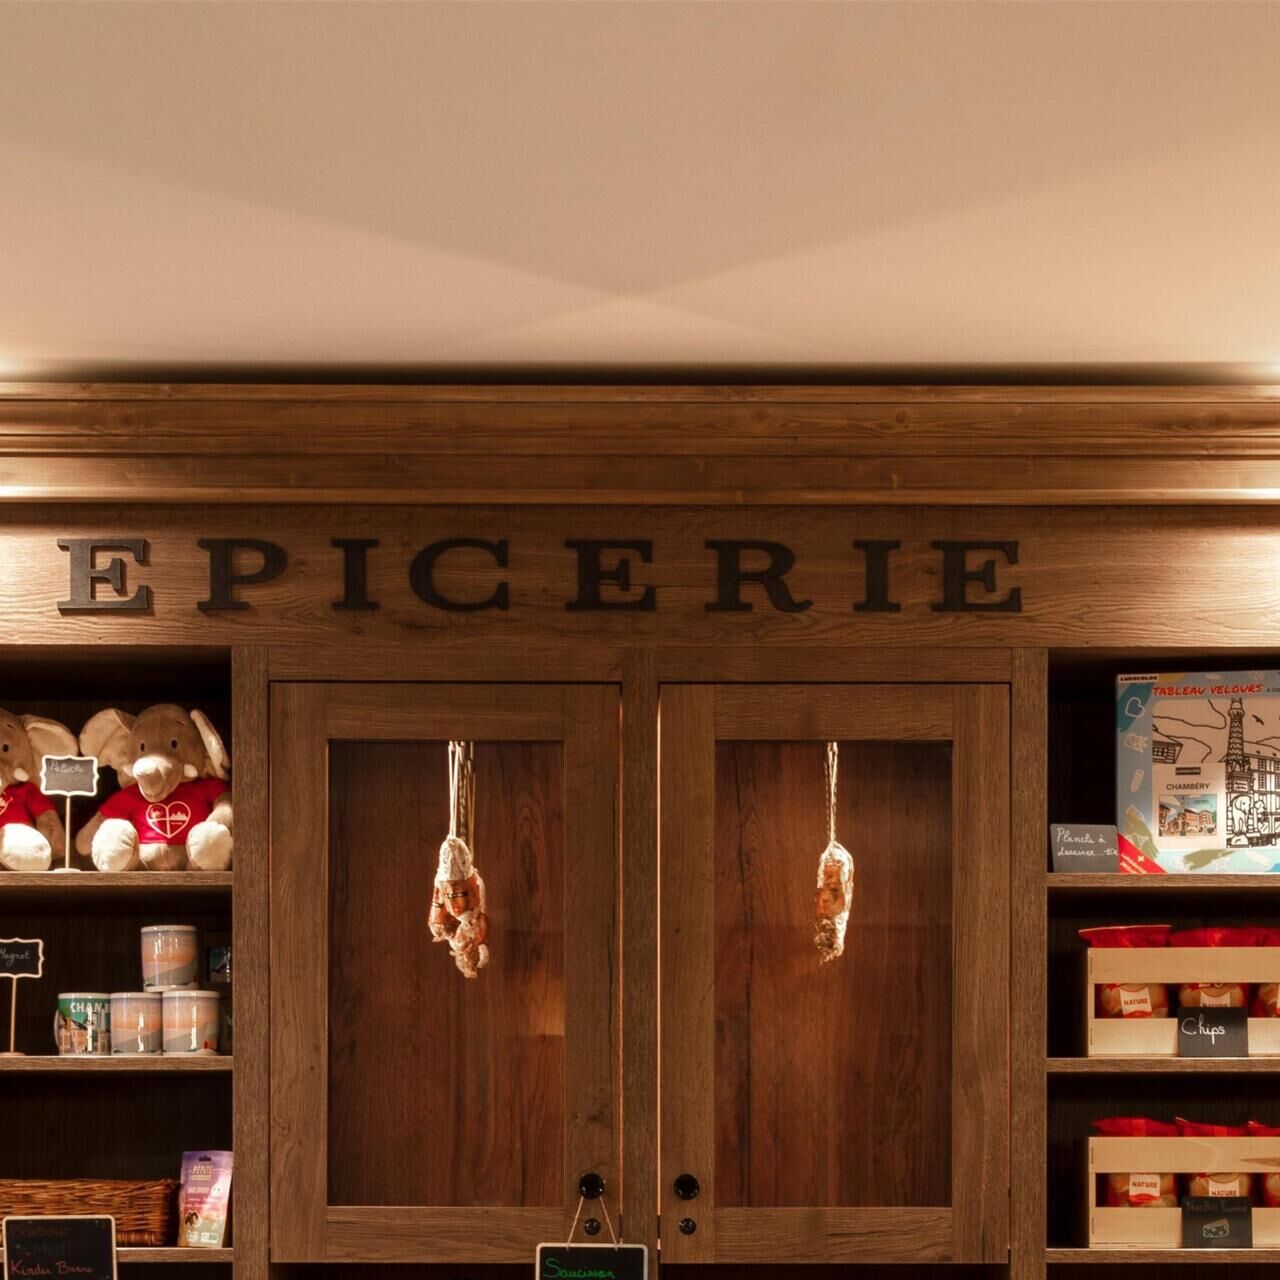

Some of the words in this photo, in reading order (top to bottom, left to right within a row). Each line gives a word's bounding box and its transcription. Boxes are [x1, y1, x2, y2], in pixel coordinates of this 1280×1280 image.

[56, 537, 1024, 614] EPICERIE
[1152, 686, 1205, 698] TABLEAU
[1209, 683, 1264, 696] VELOURS
[1166, 781, 1210, 791] CHAMBÉRY
[1123, 996, 1149, 1007] NATURE
[1181, 1013, 1226, 1045] Chips
[1131, 1179, 1159, 1189] NATURE
